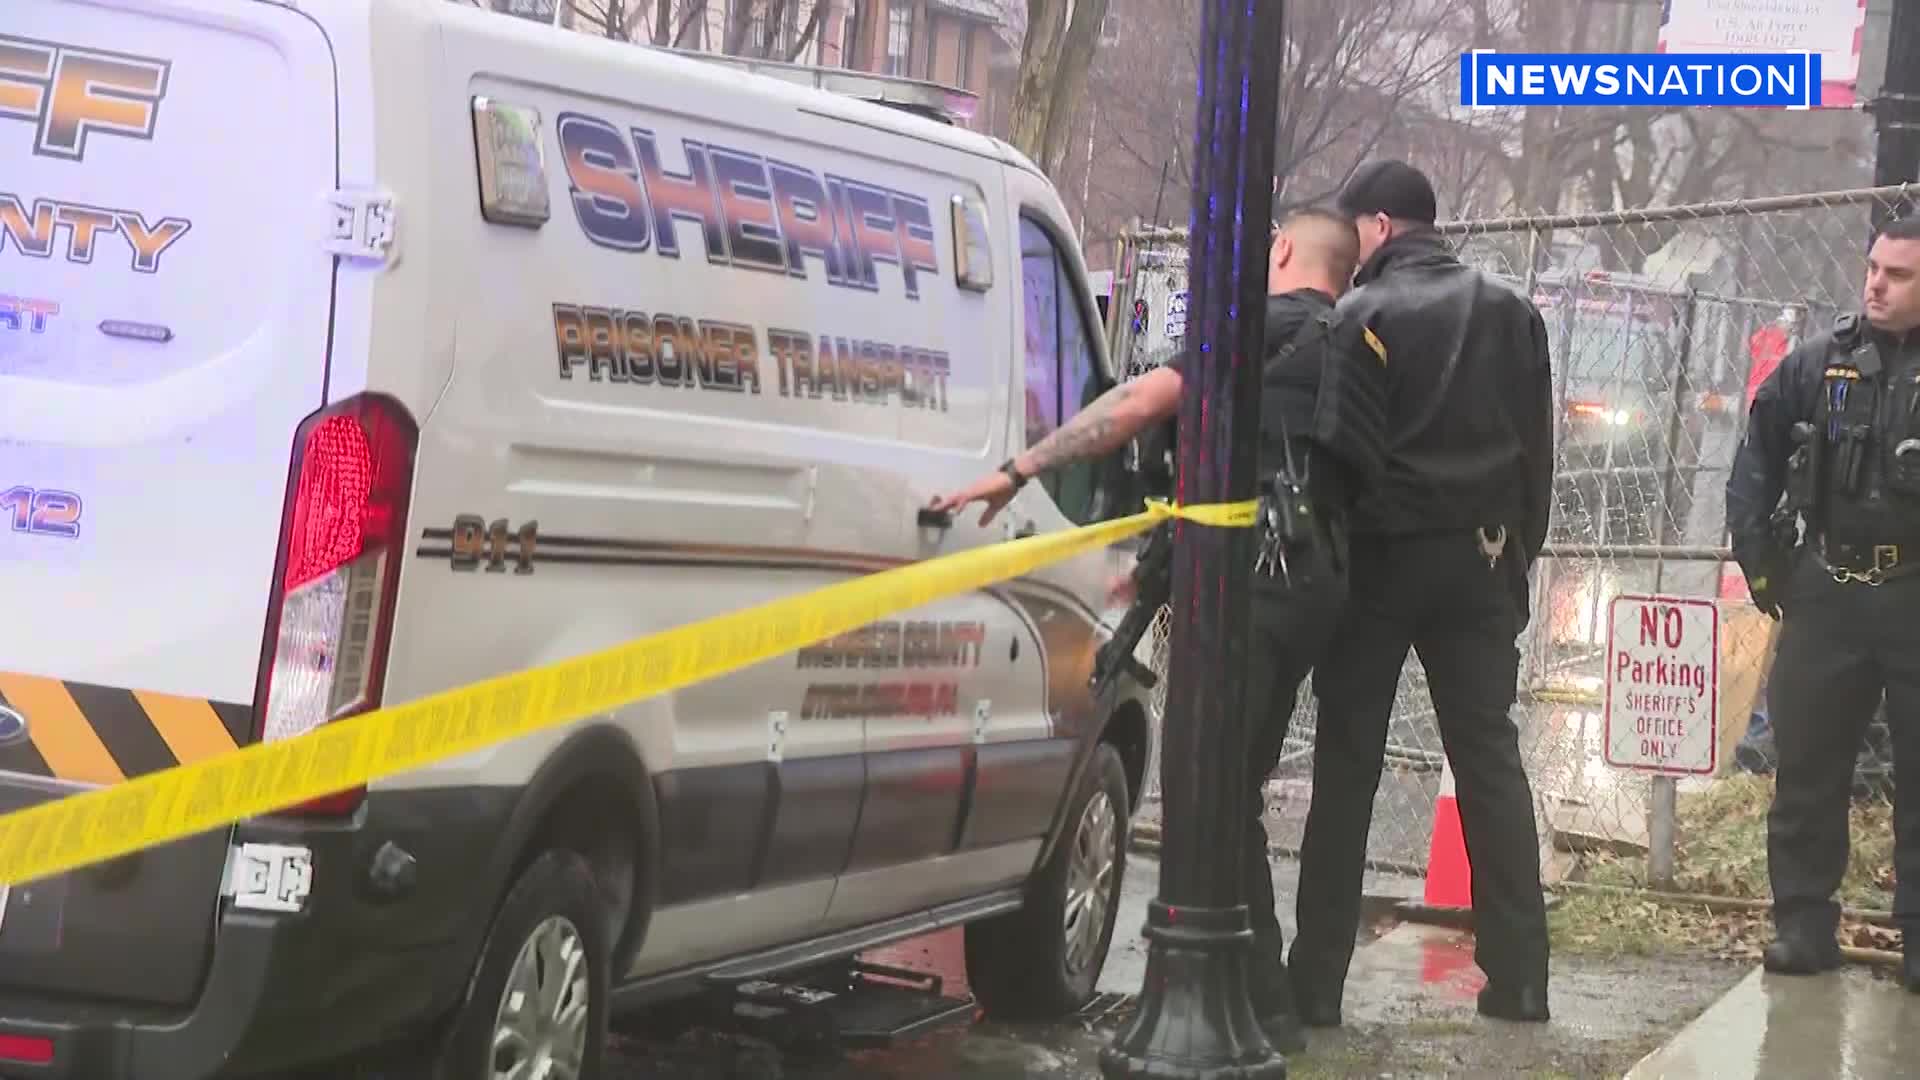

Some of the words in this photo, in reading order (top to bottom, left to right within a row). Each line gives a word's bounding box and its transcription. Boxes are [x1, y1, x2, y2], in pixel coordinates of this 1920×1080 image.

[557, 111, 939, 300] SHERIFF
[553, 302, 760, 394] PRISONER
[767, 328, 951, 412] TRANSPORT
[451, 514, 539, 575] 911
[1639, 605, 1682, 648] NO
[1617, 651, 1705, 698] Parking
[1625, 692, 1697, 714] SHERIFF'S
[1636, 716, 1685, 737] OFFICE
[1640, 739, 1677, 759] ONLY
